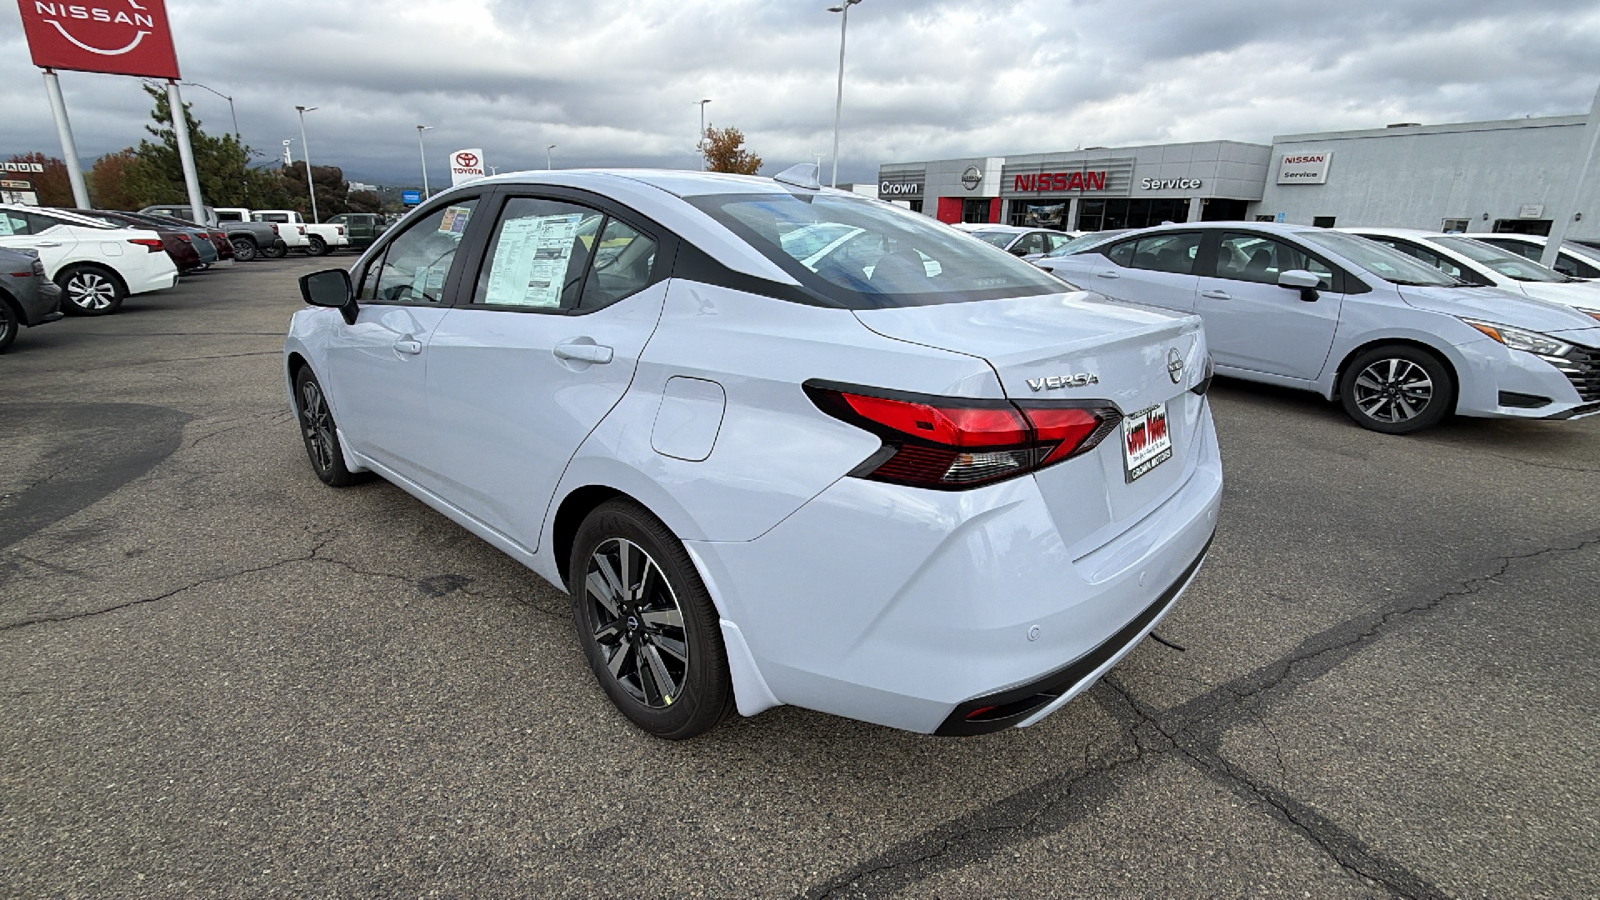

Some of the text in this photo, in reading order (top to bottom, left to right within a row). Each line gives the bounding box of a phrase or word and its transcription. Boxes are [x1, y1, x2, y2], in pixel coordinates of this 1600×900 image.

[35, 1, 154, 28] NISSAN
[1285, 156, 1324, 164] NISSAN
[453, 168, 483, 176] TOYOTA
[881, 181, 918, 194] Crown
[1014, 171, 1106, 192] NISSAN
[1141, 177, 1202, 191] Service
[1026, 372, 1099, 392] VERSA
[1132, 461, 1152, 479] CROWN
[1151, 448, 1171, 466] MOTORS
